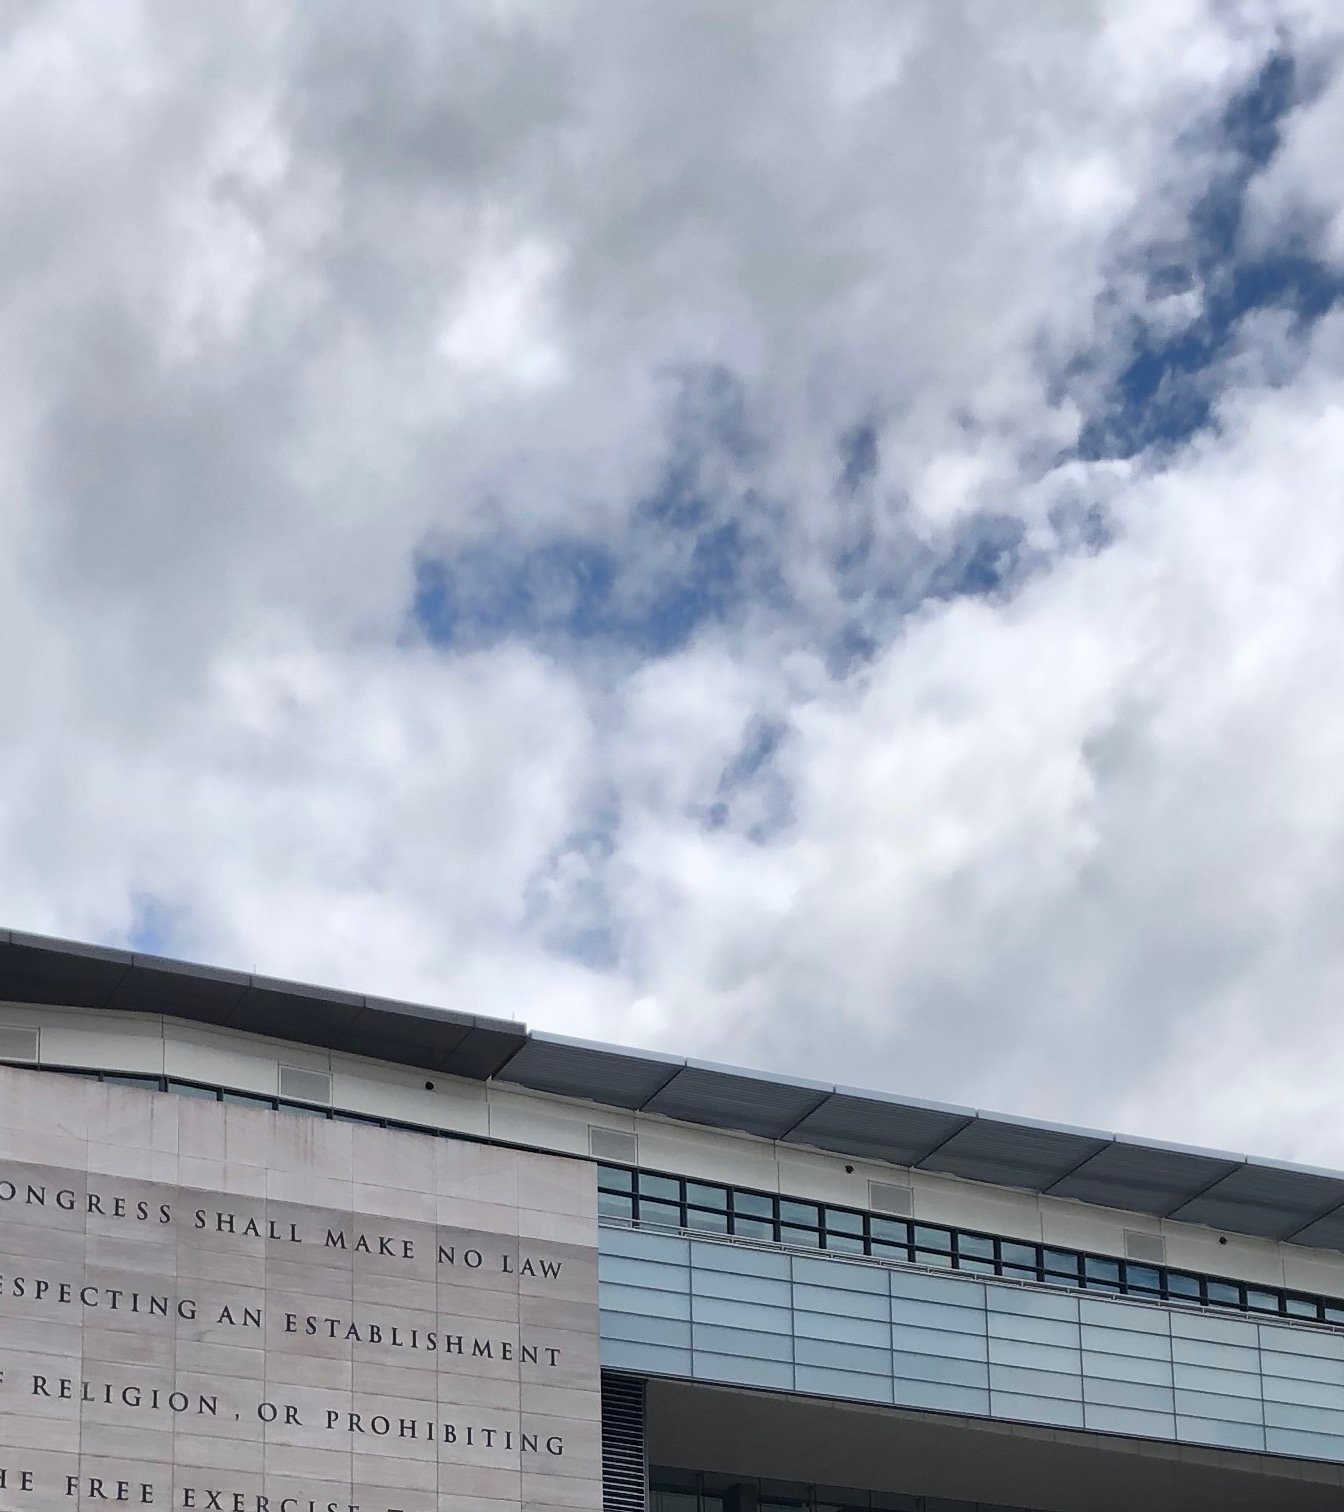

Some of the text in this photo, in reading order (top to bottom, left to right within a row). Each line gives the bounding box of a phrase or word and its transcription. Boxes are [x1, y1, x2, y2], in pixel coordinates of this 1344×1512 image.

[194, 1209, 302, 1243] SHALL
[324, 1228, 415, 1259] MAKE
[437, 1245, 483, 1268] NO
[501, 1254, 563, 1280] LAW
[216, 1304, 263, 1328] AN
[284, 1312, 561, 1367] ESTABLISHMENT
[31, 1375, 240, 1421] RELIGION,
[257, 1402, 303, 1426] OR
[325, 1409, 564, 1460] PROHIBITING
[65, 1475, 154, 1504] FREE
